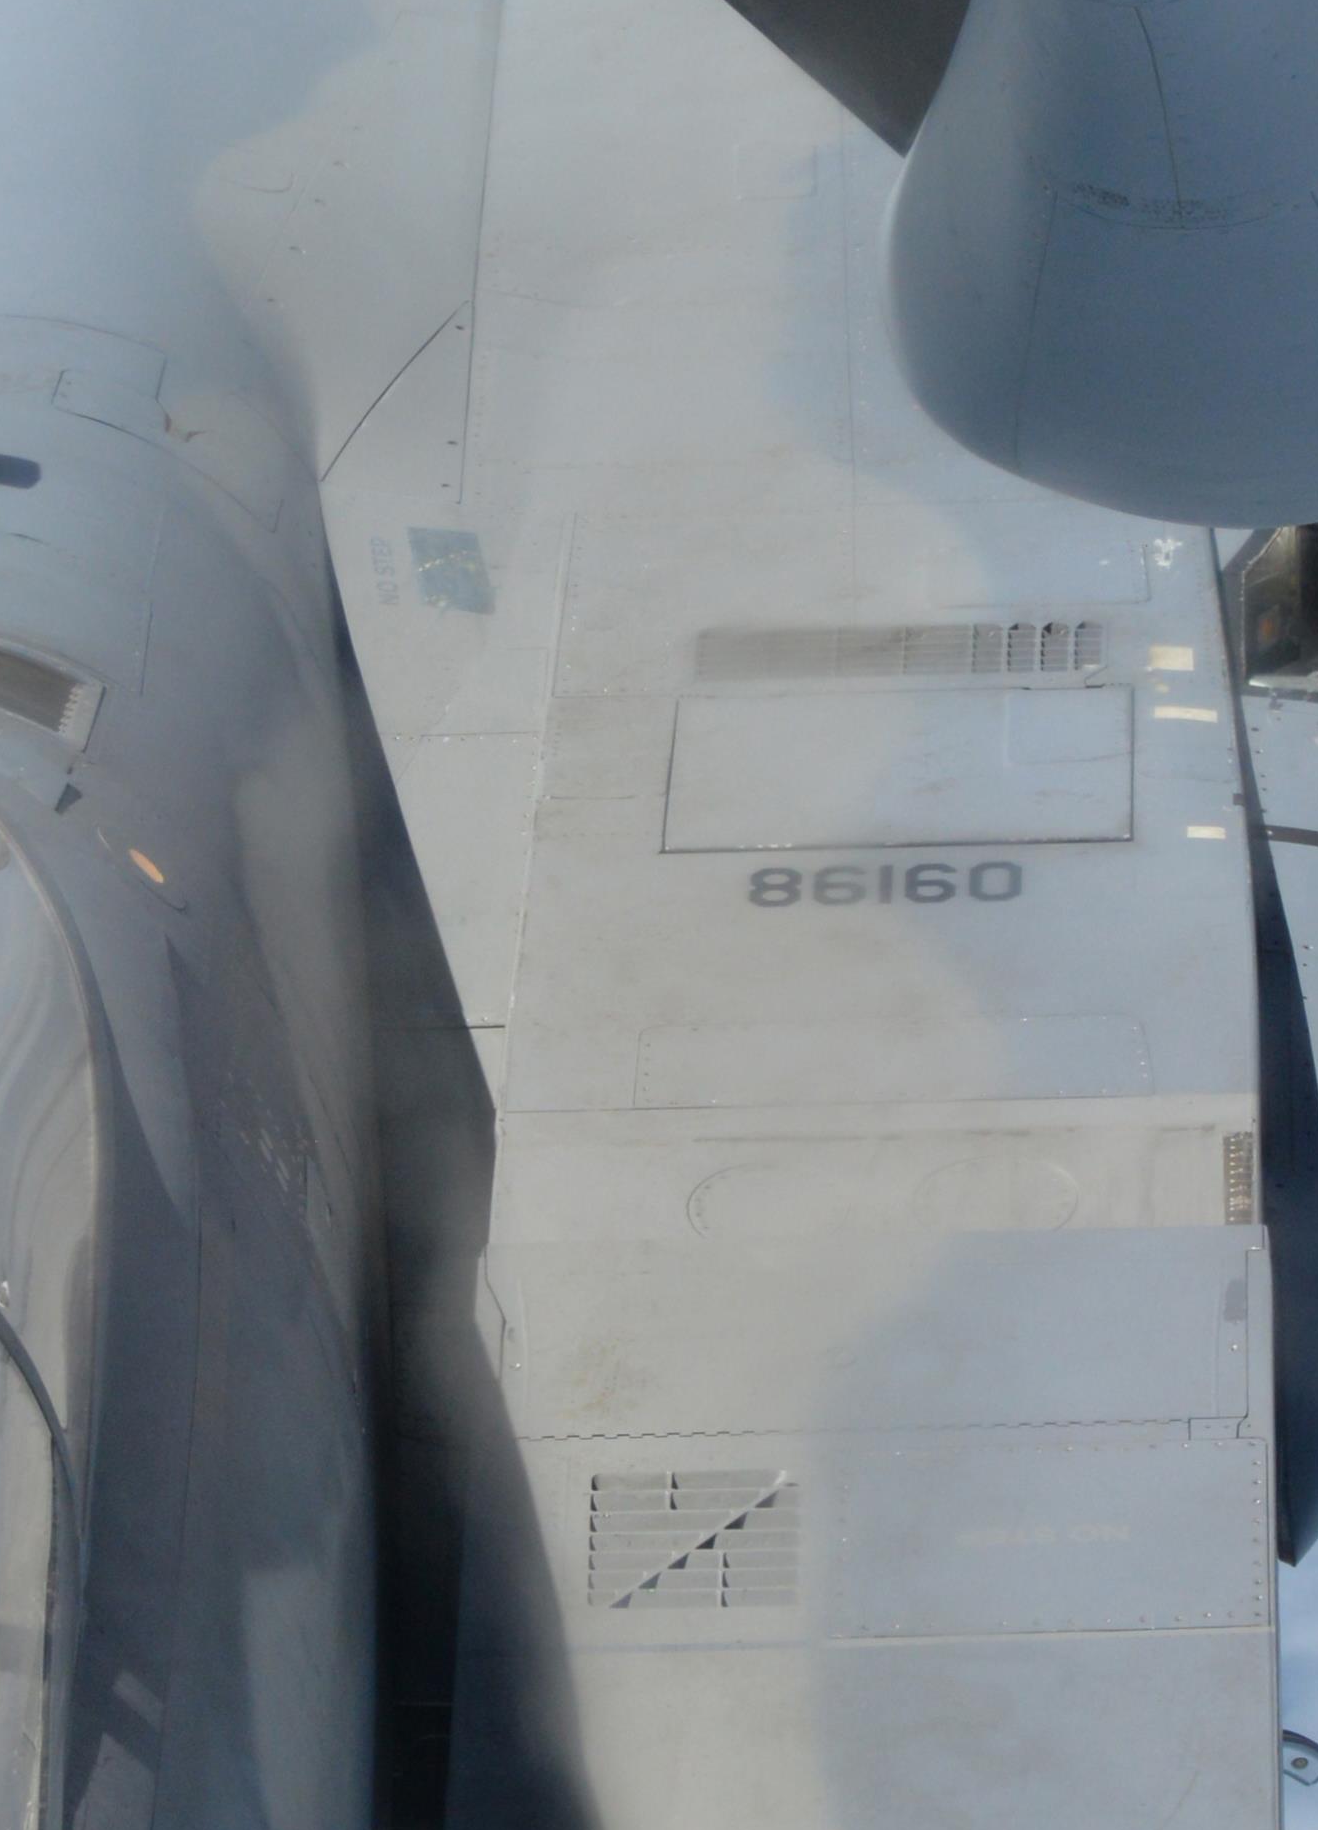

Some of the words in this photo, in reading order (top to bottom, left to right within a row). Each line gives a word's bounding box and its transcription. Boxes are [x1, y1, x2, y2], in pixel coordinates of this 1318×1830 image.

[368, 536, 396, 577] STEP
[375, 581, 400, 606] NO
[747, 860, 1024, 908] 86160
[1068, 1523, 1132, 1544] NO
